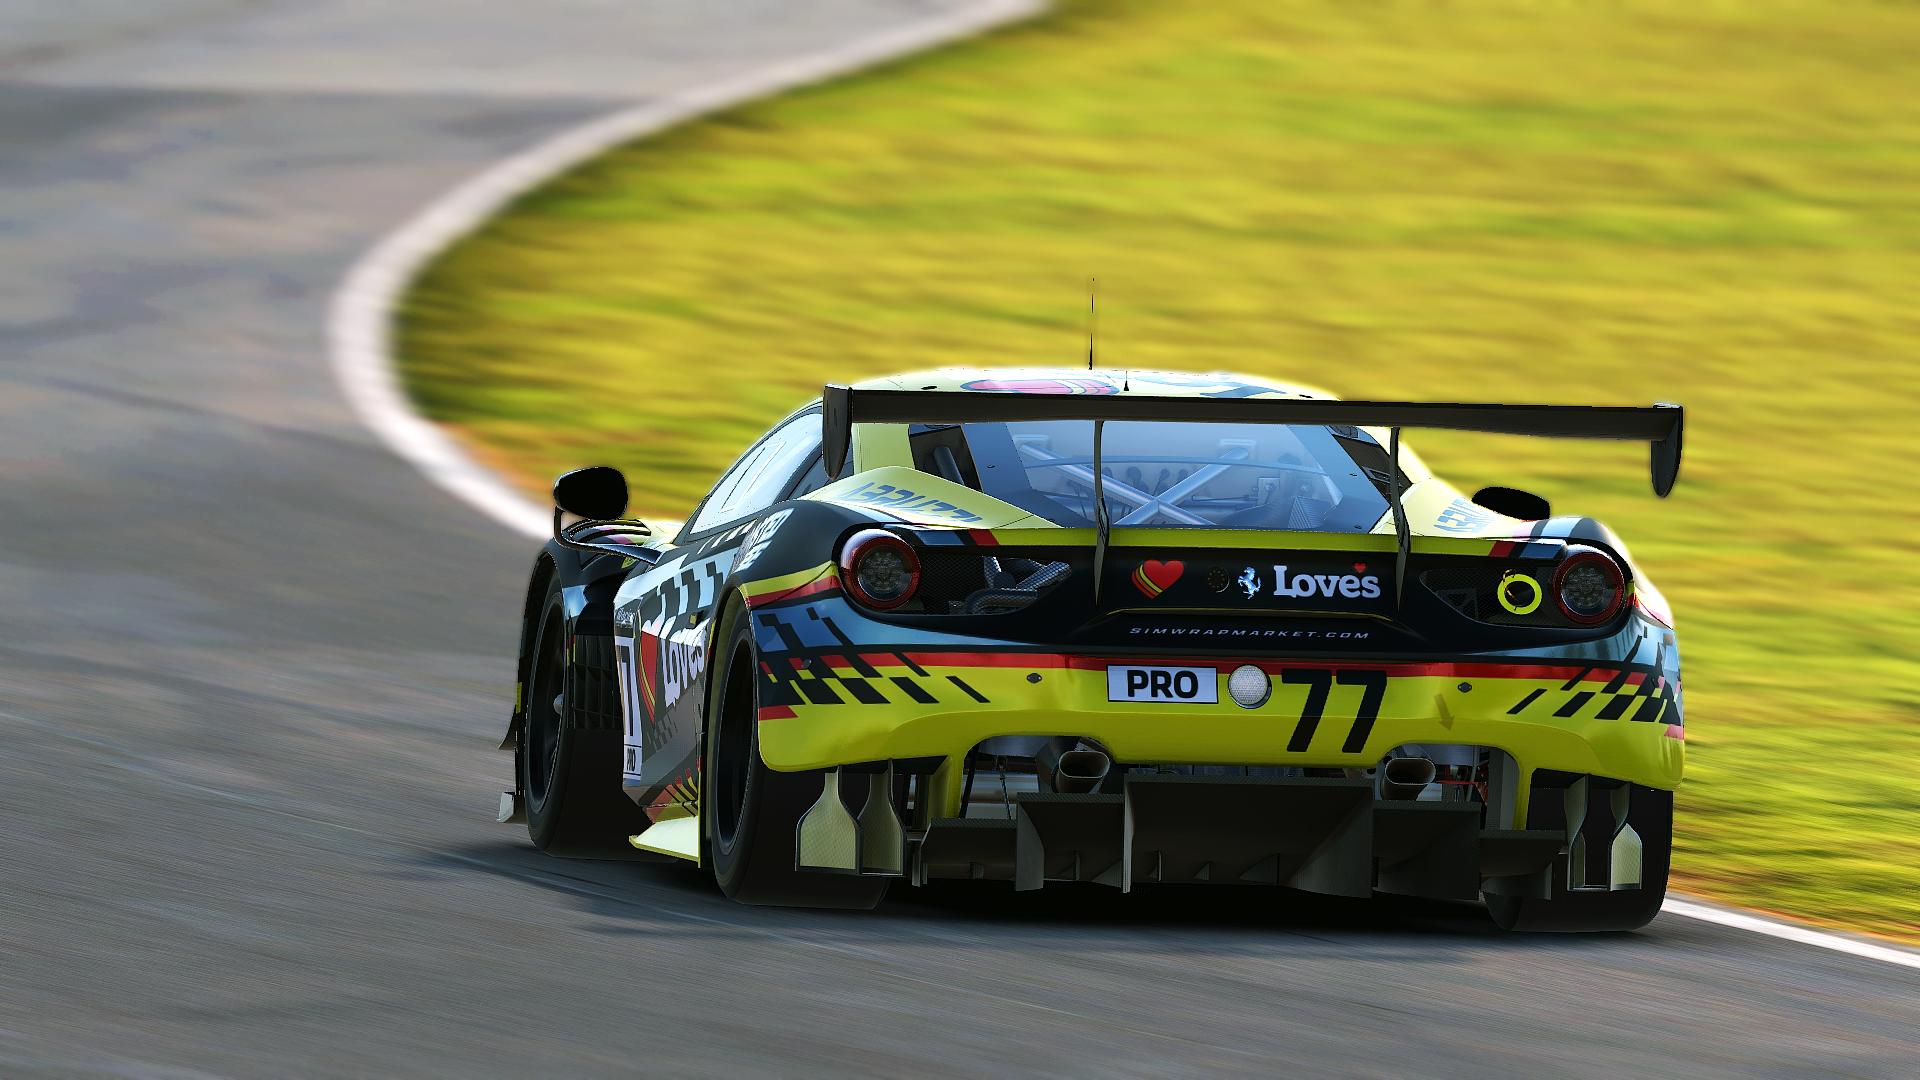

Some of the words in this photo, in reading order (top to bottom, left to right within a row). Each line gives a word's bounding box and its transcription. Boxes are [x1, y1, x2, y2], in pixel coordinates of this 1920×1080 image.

[1129, 626, 1370, 640] SIMWRAPMARKET.COM
[1126, 669, 1199, 699] PRO
[1281, 667, 1387, 754] 77
[626, 747, 636, 772] PRO
